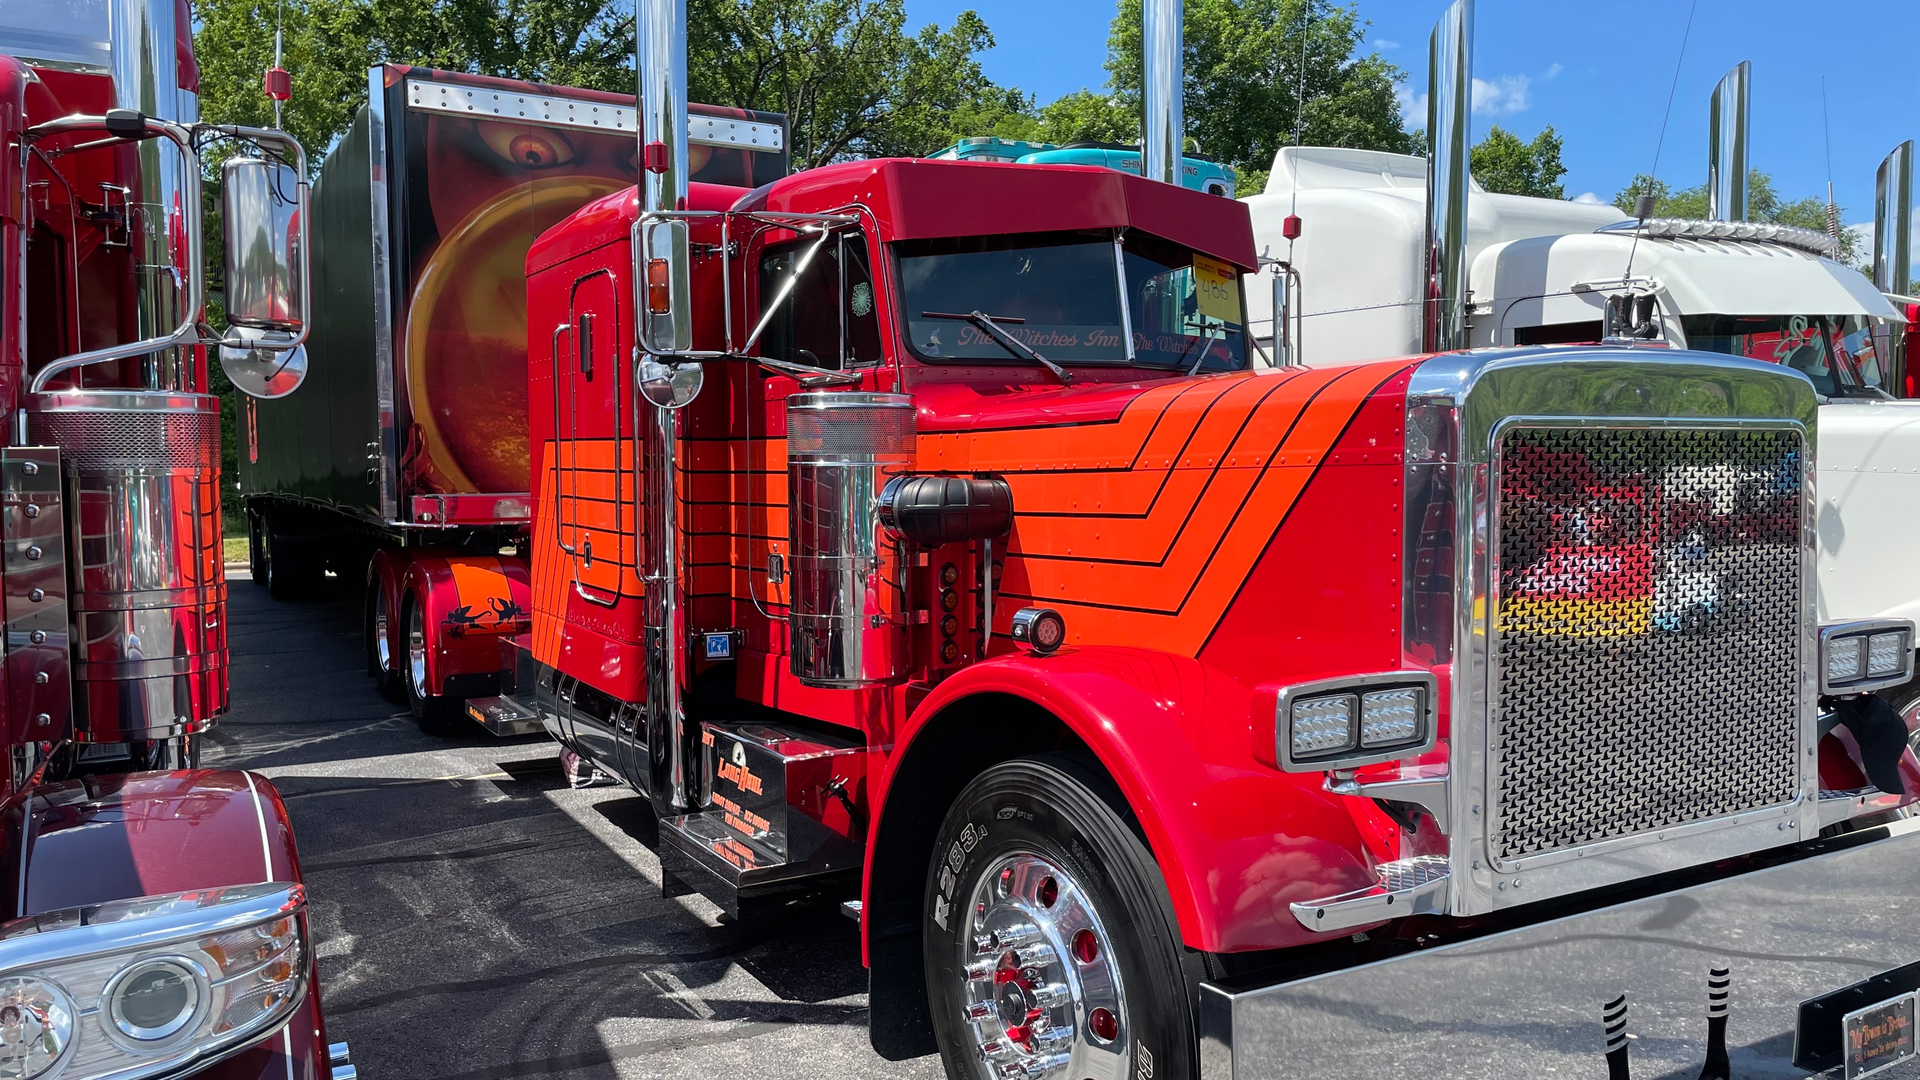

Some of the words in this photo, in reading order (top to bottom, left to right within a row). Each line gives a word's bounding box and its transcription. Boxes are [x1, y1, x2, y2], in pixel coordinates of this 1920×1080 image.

[1202, 279, 1229, 300] 486
[957, 326, 995, 346] The
[1004, 328, 1081, 347] Witches
[1084, 329, 1120, 347] Inn
[1133, 332, 1155, 351] The
[1156, 335, 1199, 355] Witches
